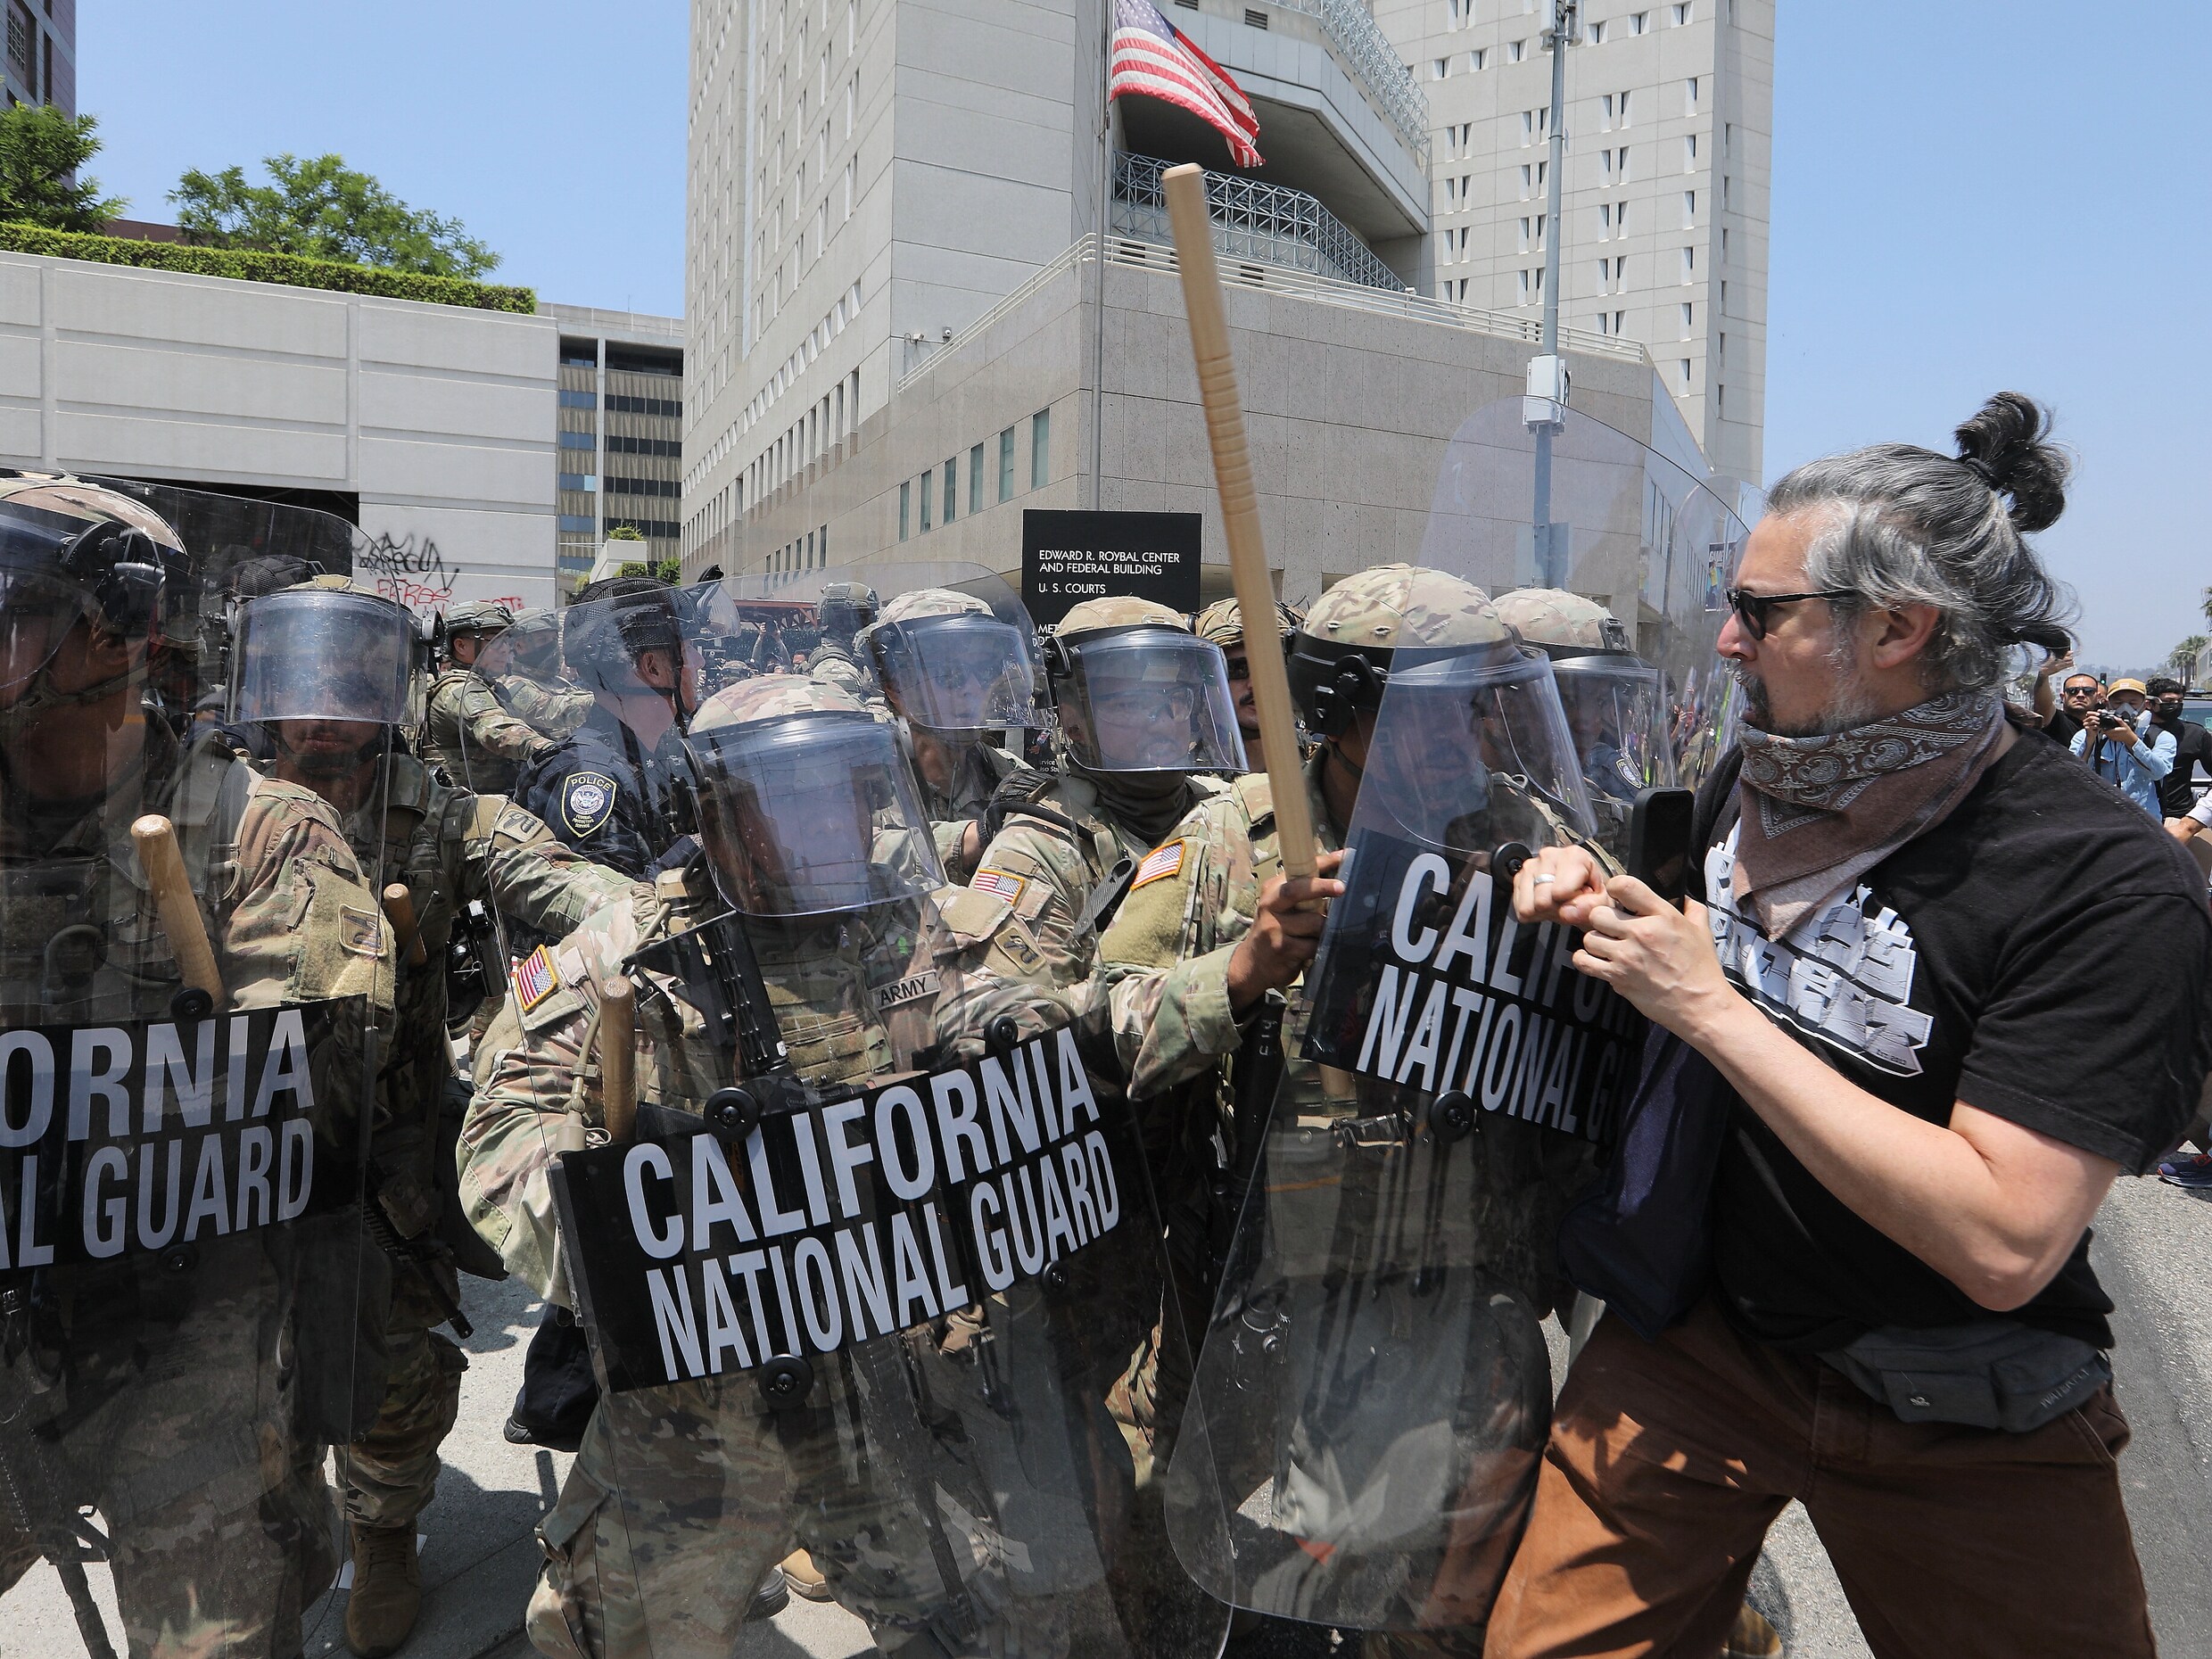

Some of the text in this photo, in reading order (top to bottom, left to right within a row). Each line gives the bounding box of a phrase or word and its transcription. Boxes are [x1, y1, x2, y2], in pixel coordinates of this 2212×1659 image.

[1039, 549, 1180, 564] EDWARD R. ROYBAL CENTER
[1039, 563, 1162, 575] AND FEDERAL BUILDING
[1065, 583, 1106, 594] COURTS
[571, 776, 612, 791] POLICE
[880, 977, 926, 1006] ARMY
[0, 1009, 315, 1148] ORNIA
[1356, 964, 1579, 1134] NATIONAL
[623, 1027, 1100, 1259] CALIFORNIA
[83, 1118, 314, 1259] GUARD
[646, 1130, 1119, 1382] NATIONAL GUARD
